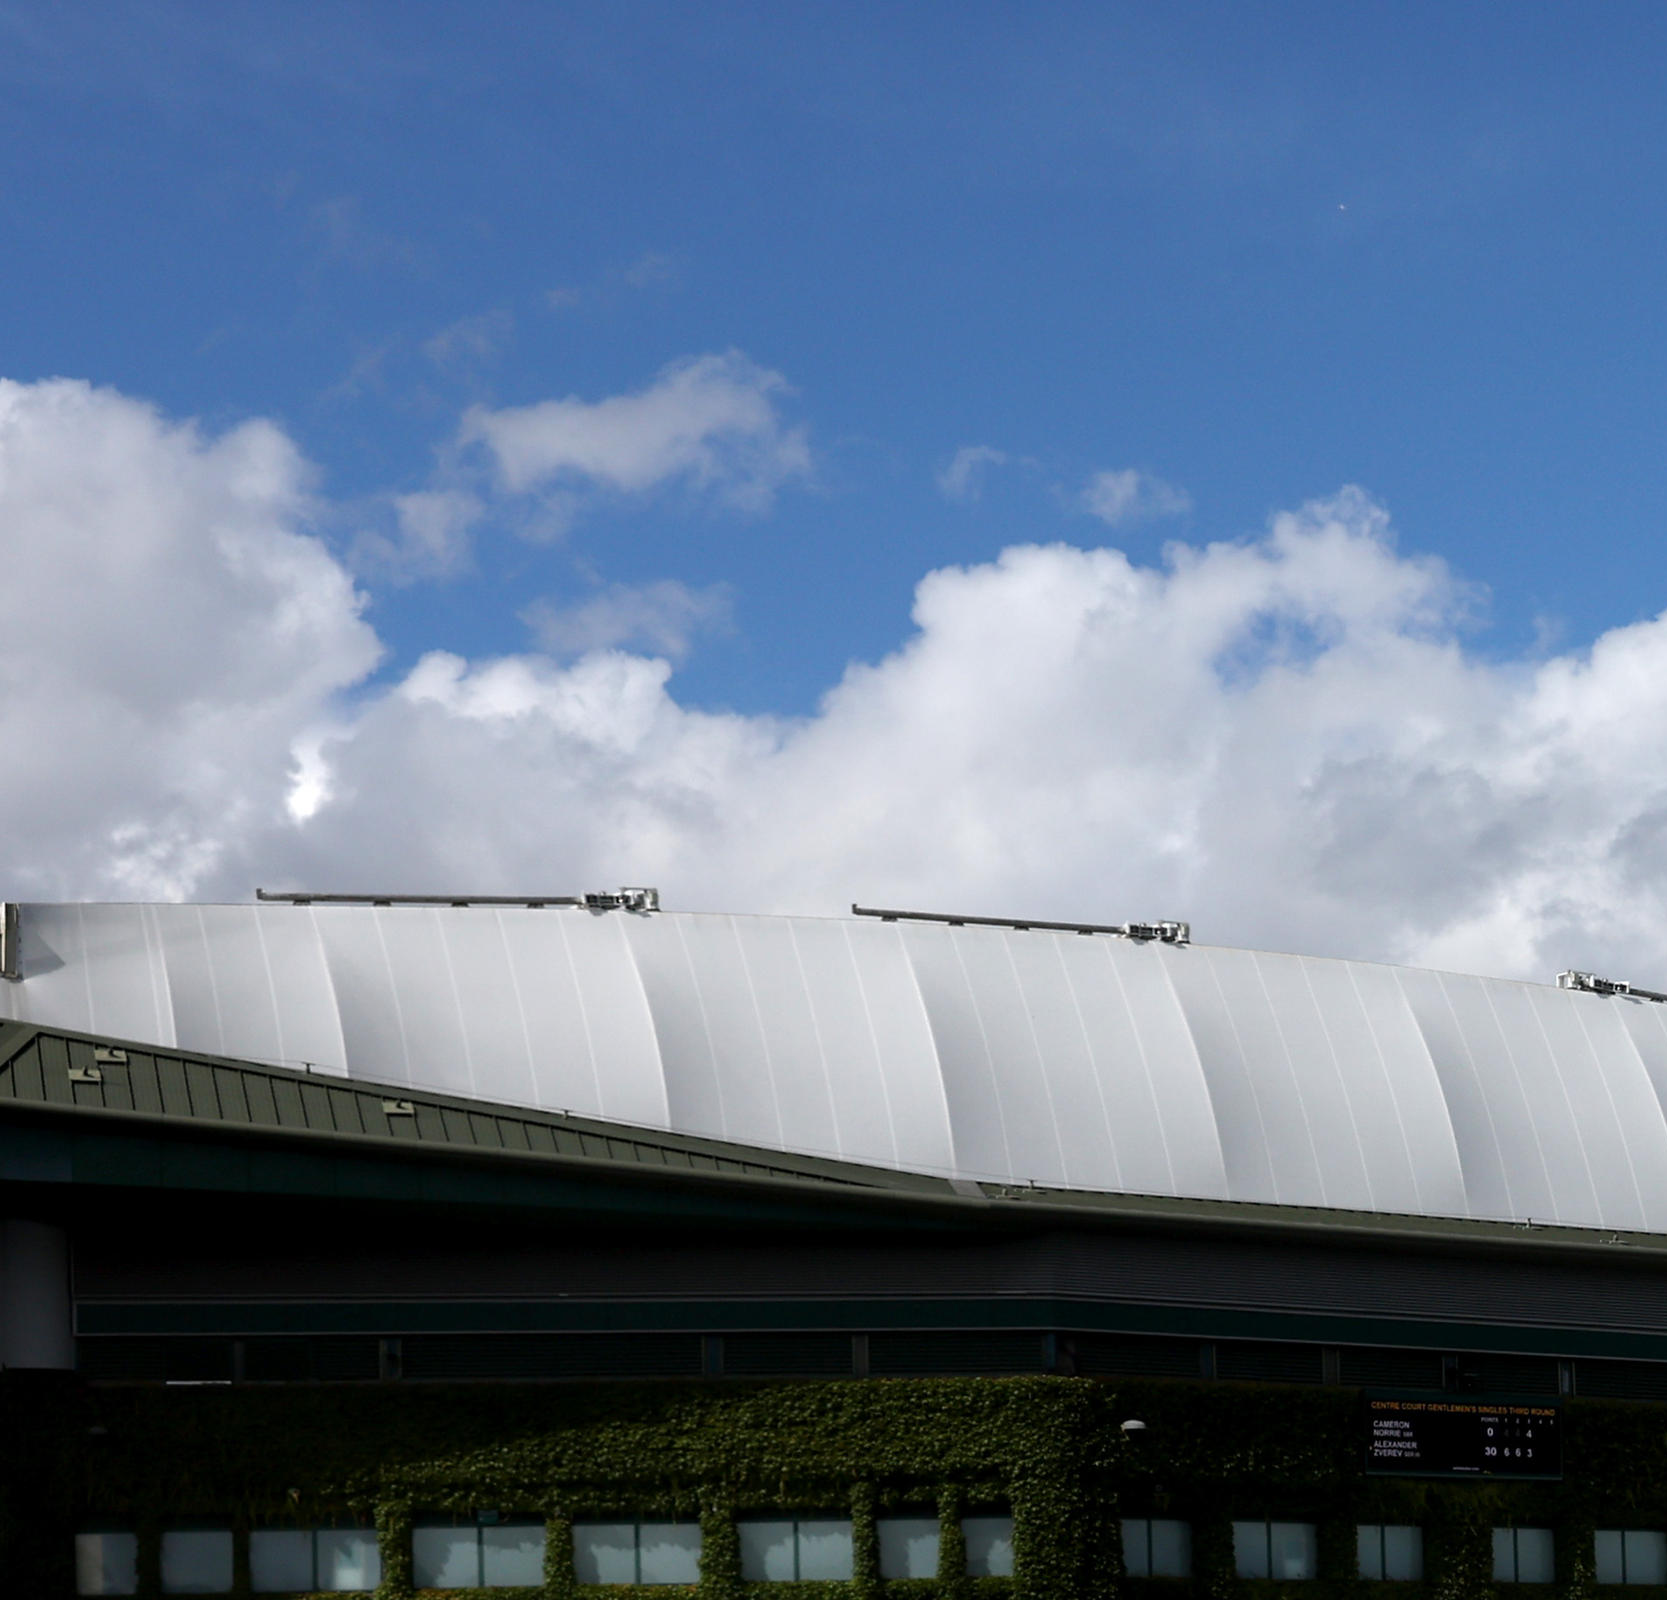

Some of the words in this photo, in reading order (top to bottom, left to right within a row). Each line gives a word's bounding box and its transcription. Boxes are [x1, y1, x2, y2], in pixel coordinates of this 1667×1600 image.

[1370, 1401, 1400, 1410] CENTRE
[1401, 1402, 1426, 1411] COURT
[1478, 1405, 1507, 1415] SINGLES
[1509, 1407, 1529, 1415] THIRD
[1531, 1407, 1556, 1417] ROUND
[1373, 1420, 1410, 1429] CAMERON
[1373, 1429, 1401, 1437] NORRIE
[1486, 1427, 1494, 1437] 0
[1525, 1429, 1533, 1439] 4
[1373, 1440, 1418, 1449] ALEXANDER
[1373, 1449, 1403, 1458] ZVEREV
[1484, 1446, 1498, 1456] 30
[1503, 1447, 1510, 1457] 6
[1515, 1448, 1521, 1458] 6
[1526, 1448, 1533, 1458] 3
